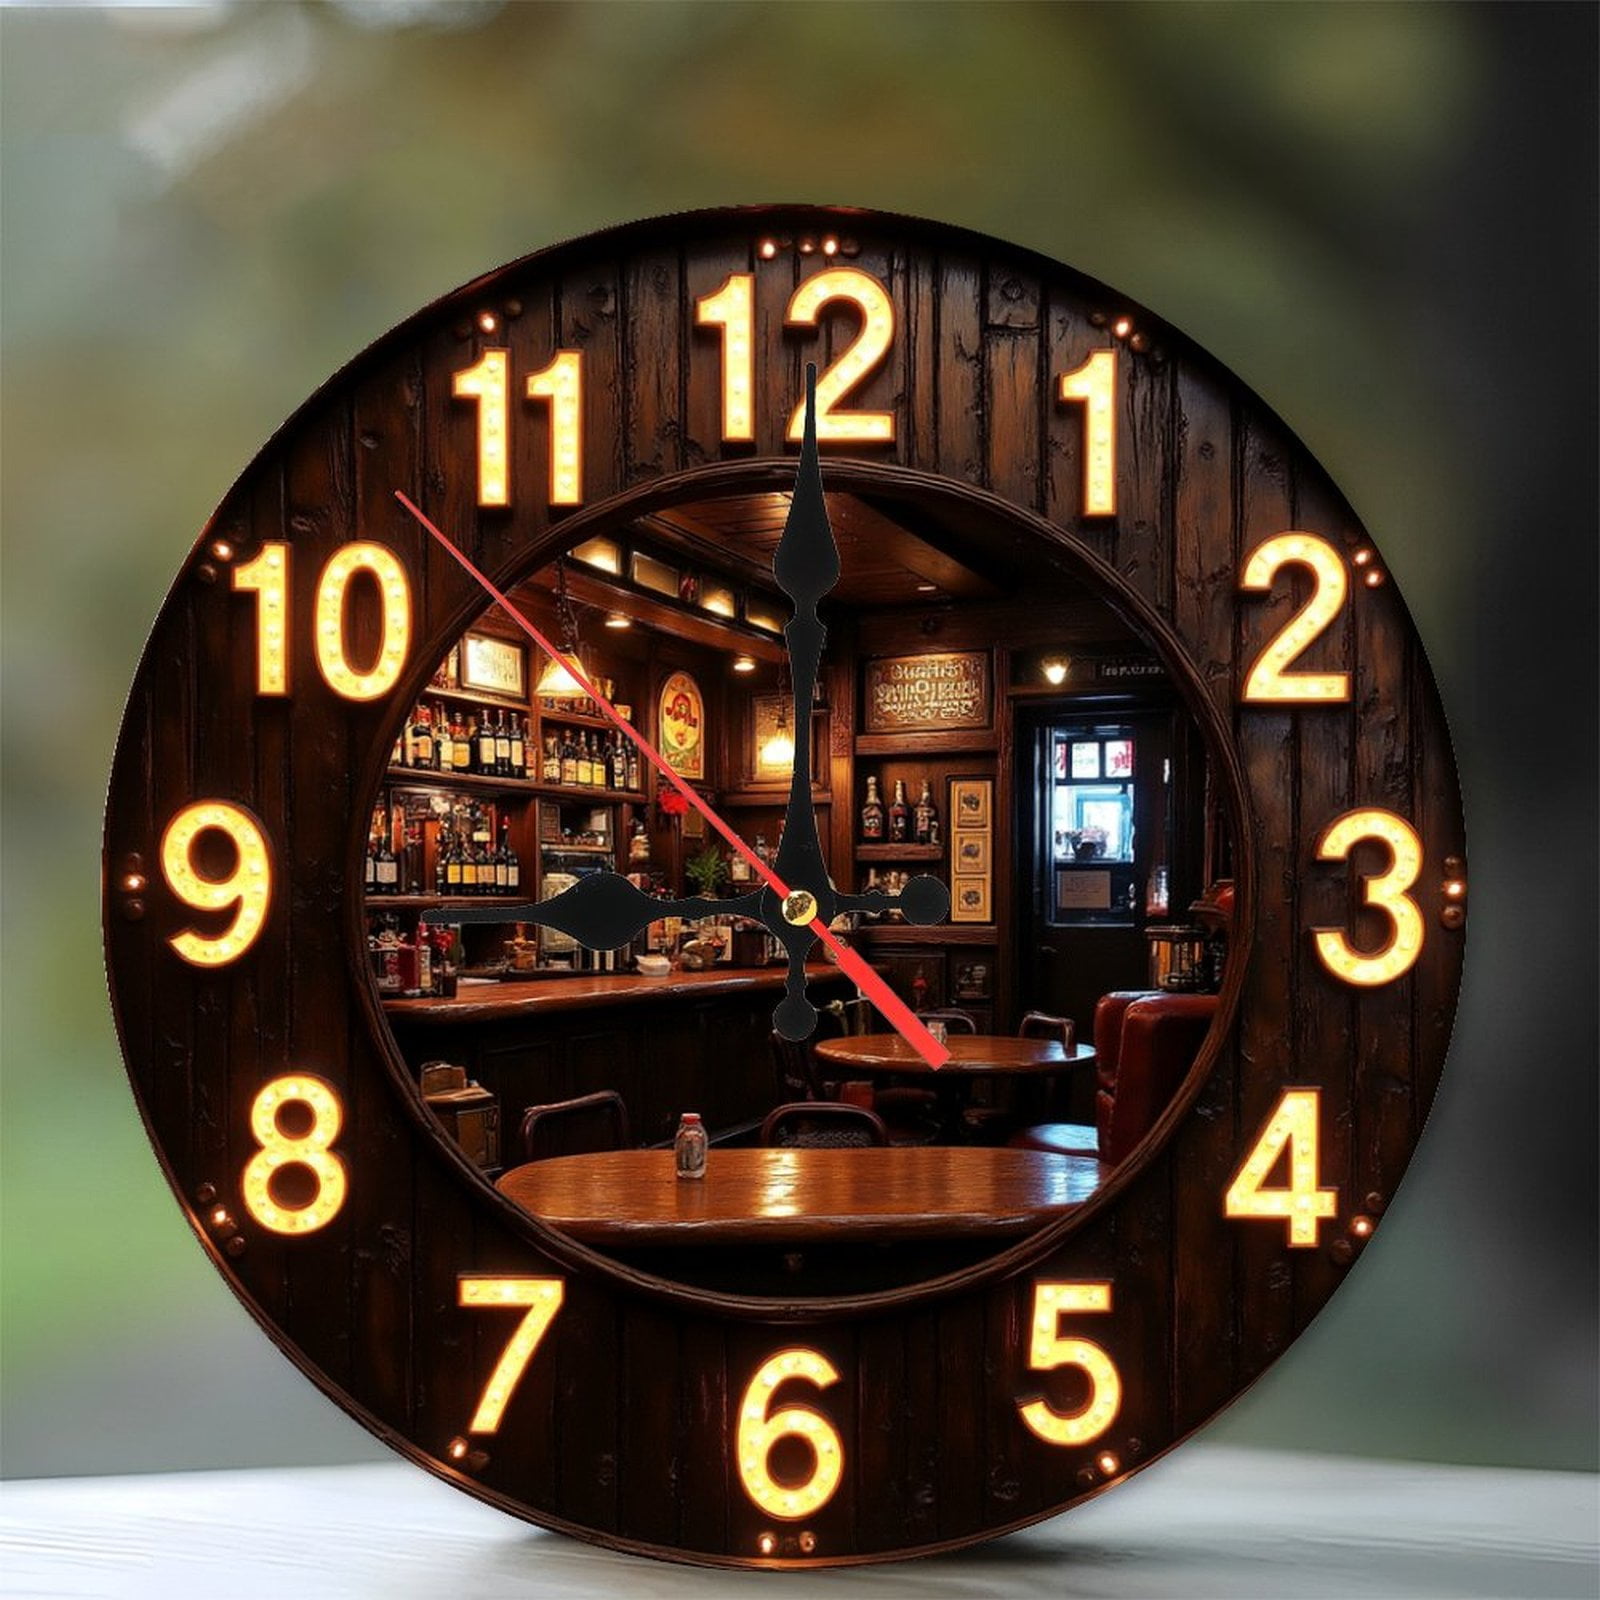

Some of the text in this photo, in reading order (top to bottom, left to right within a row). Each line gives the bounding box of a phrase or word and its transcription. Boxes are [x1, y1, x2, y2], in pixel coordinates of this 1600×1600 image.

[453, 349, 583, 507] 11
[696, 268, 895, 442] 12
[1060, 350, 1117, 516] 1
[232, 541, 412, 700] 10
[1242, 532, 1349, 703] 2
[160, 801, 272, 967] 9
[1314, 809, 1424, 987] 3
[241, 1074, 348, 1236] 8
[1224, 1089, 1338, 1247] 4
[458, 1277, 564, 1434] 7
[736, 1347, 844, 1520] 6
[1020, 1282, 1122, 1447] 5
